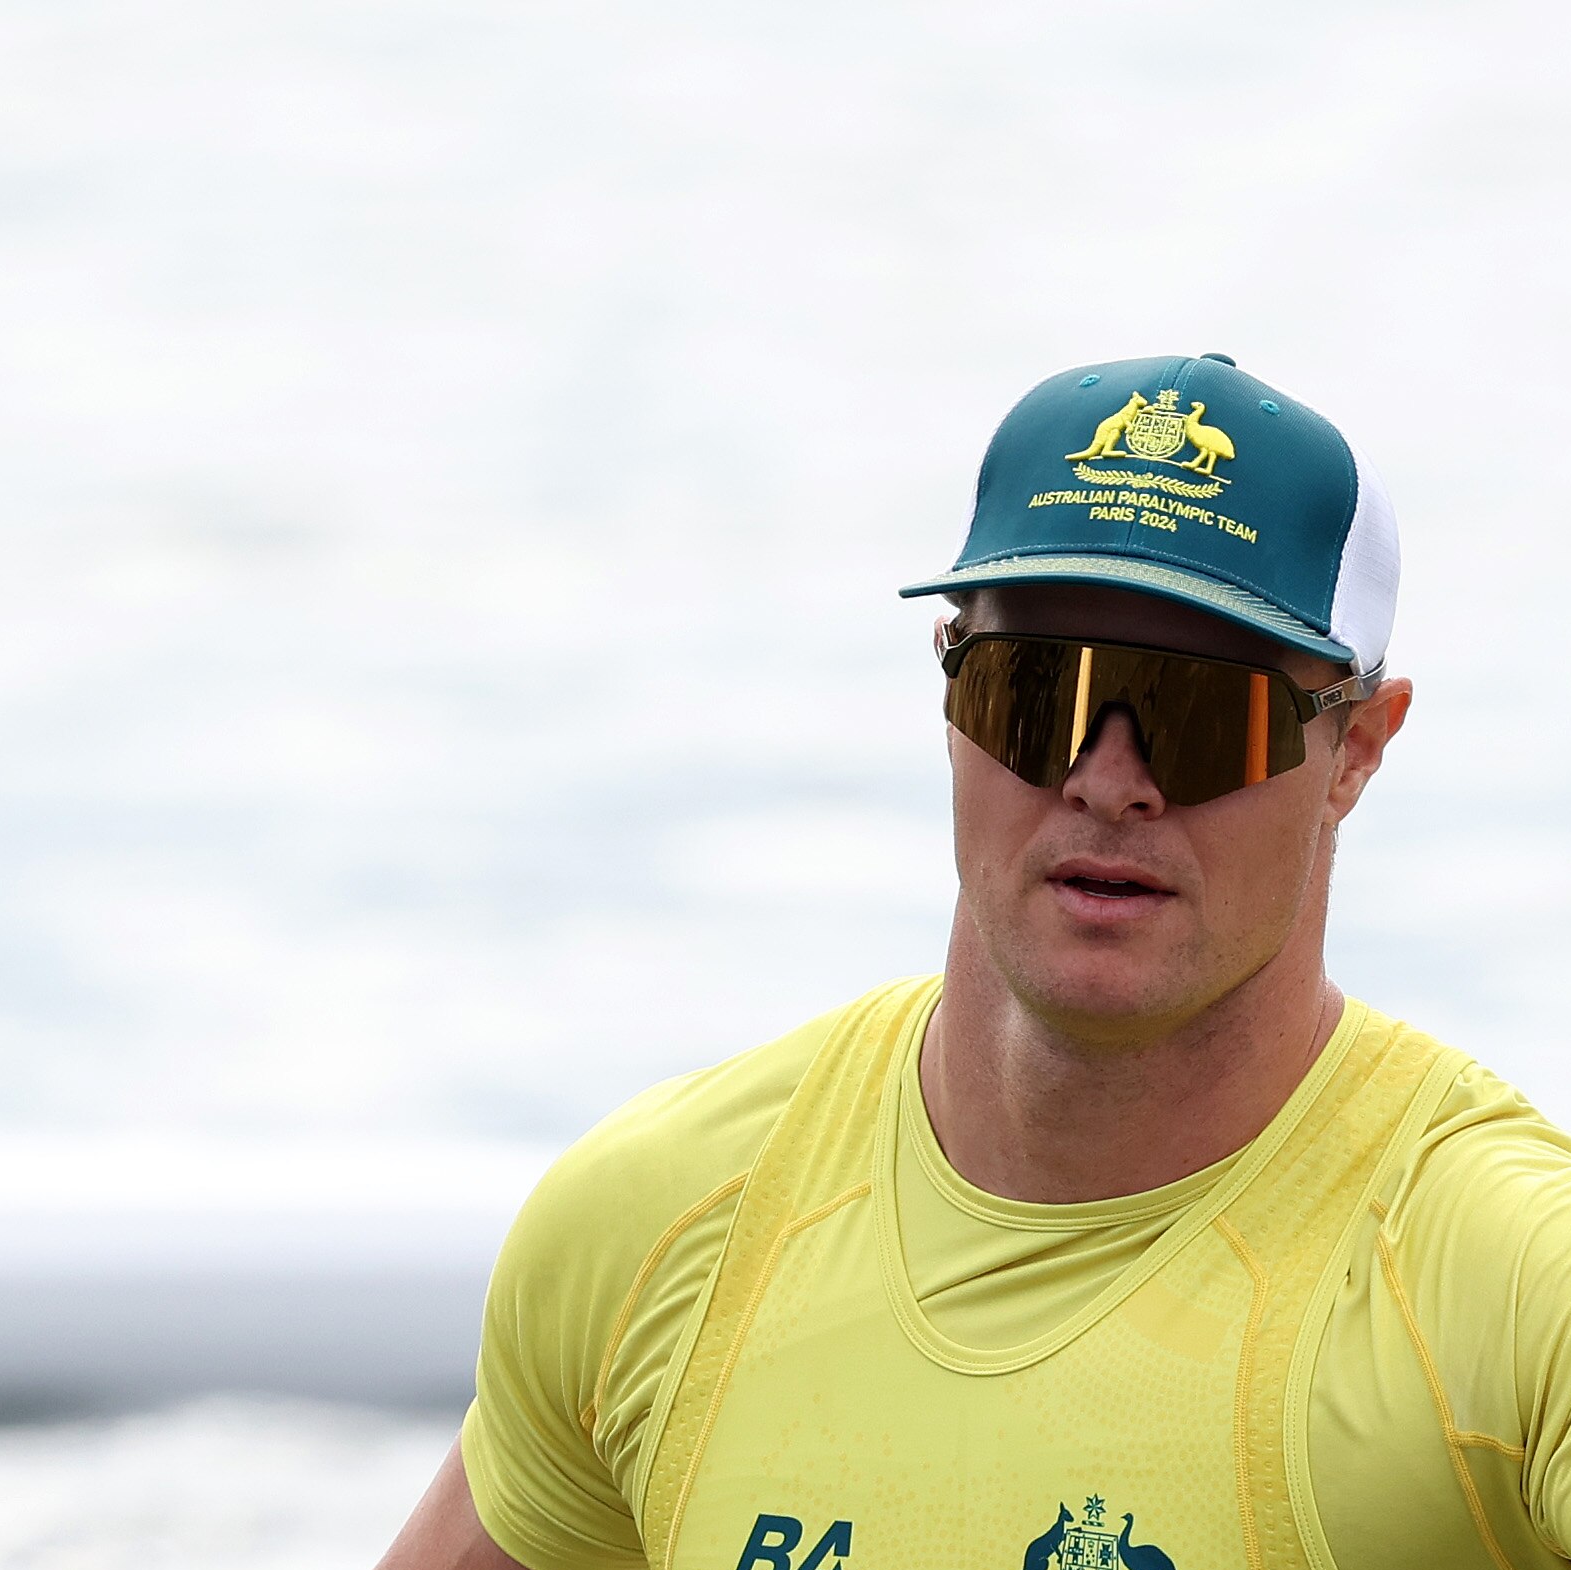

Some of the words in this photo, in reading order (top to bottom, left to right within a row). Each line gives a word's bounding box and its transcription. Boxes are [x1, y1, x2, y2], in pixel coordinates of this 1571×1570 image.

[1028, 490, 1115, 508] AUSTRALIAN
[1117, 491, 1214, 525] PARALYMPIC
[1216, 515, 1257, 544] TEAM
[1089, 506, 1135, 521] PARIS
[1138, 510, 1178, 533] 2024
